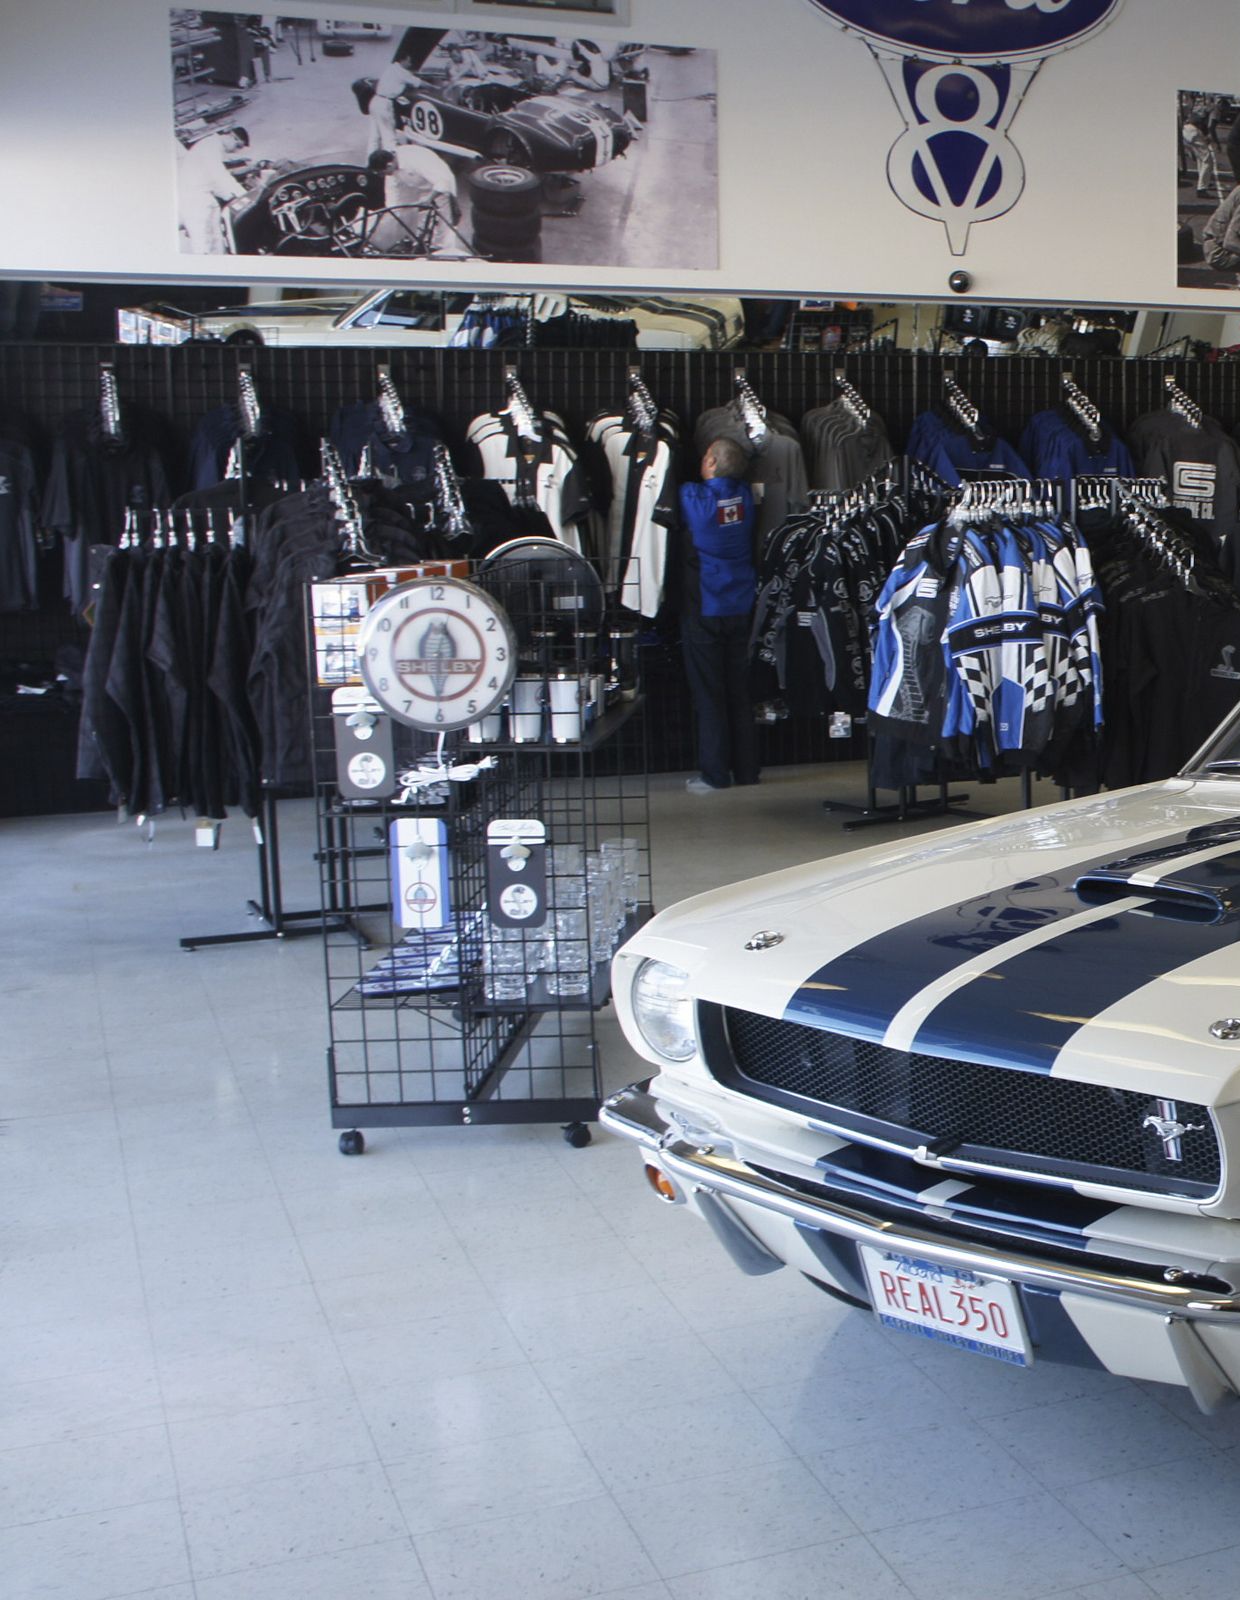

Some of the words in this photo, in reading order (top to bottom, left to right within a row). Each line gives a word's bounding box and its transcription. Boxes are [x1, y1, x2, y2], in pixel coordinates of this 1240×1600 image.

[414, 105, 439, 136] 98
[430, 586, 445, 601] 12
[400, 597, 409, 609] 11
[376, 617, 392, 632] 10
[485, 617, 497, 632] 2
[973, 621, 1027, 638] SHEBY
[369, 650, 378, 662] 9
[496, 647, 506, 662] 3
[397, 660, 481, 674] SHELBY
[379, 677, 390, 692] 8
[487, 677, 498, 691] 4
[402, 700, 413, 714] 7
[467, 700, 477, 714] 5
[435, 708, 445, 723] 6
[879, 1270, 1009, 1339] REAL350
